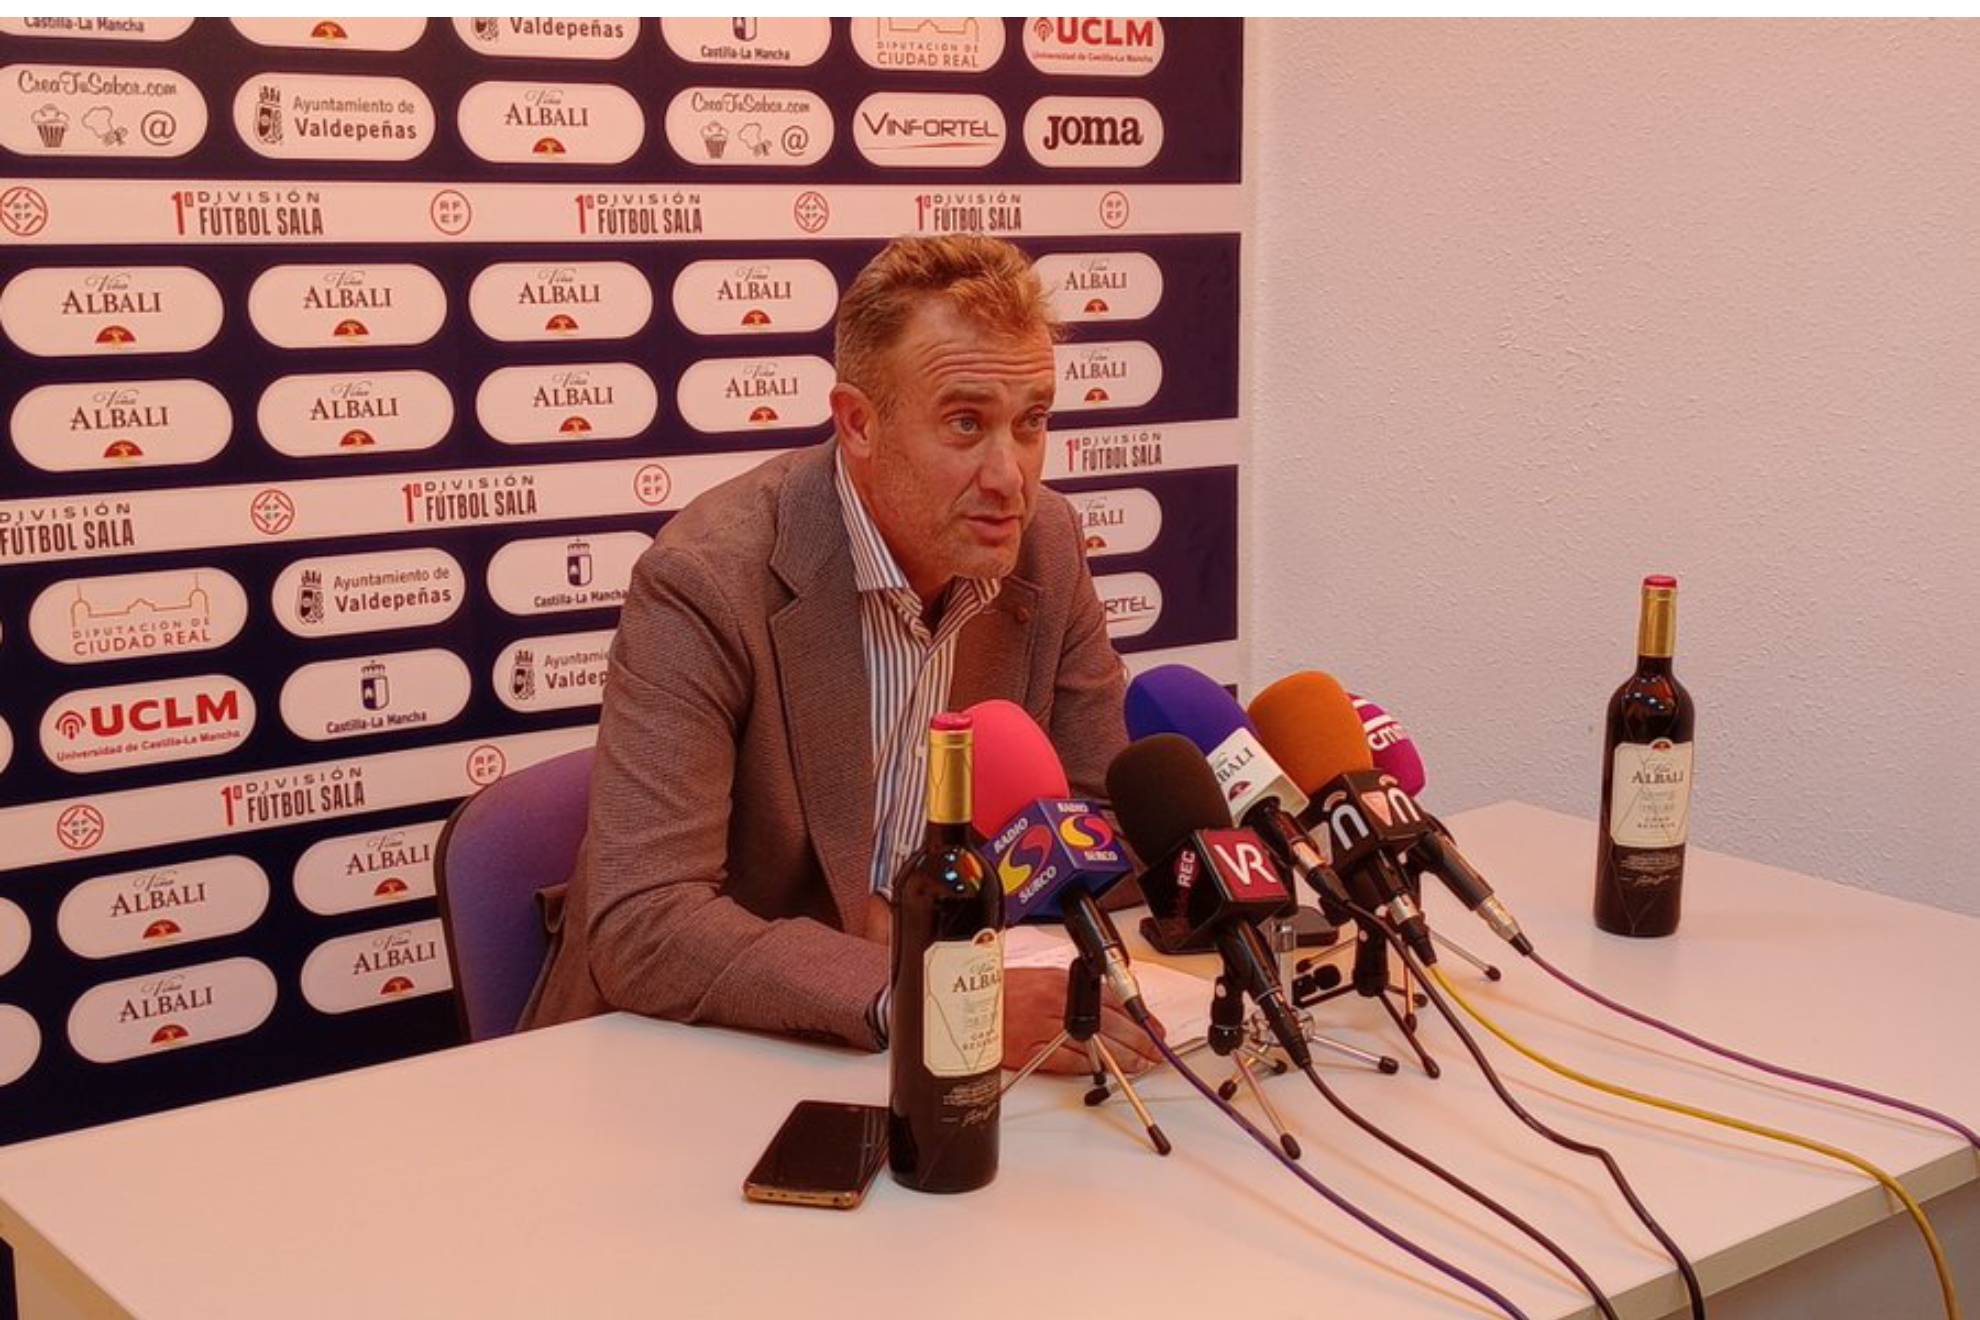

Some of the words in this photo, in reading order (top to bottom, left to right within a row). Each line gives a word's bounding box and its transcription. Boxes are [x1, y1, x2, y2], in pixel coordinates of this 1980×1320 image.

[510, 17, 624, 40] Valdepeñas
[1057, 17, 1153, 47] UCLM
[877, 51, 938, 66] CIUDAD
[943, 54, 980, 68] REAL
[293, 96, 398, 115] Ayuntamiento
[402, 101, 415, 114] de
[505, 104, 589, 127] ALBALI
[294, 118, 417, 141] Valdepeñas
[862, 111, 999, 138] VINFORTEL
[277, 206, 324, 236] SALA
[664, 207, 702, 234] SALA
[988, 206, 1022, 231] SALA
[519, 282, 600, 304] ALBALI
[717, 280, 791, 300] ALBALI
[1064, 271, 1127, 290] ALBALI
[62, 290, 161, 314] ALBALI
[303, 286, 391, 308] ALBALI
[1064, 361, 1127, 380] ALBALI
[533, 386, 614, 407] ALBALI
[725, 377, 798, 398] ALBALI
[71, 406, 169, 431] ALBALI
[310, 397, 399, 421] ALBALI
[1132, 444, 1162, 467] SALA
[494, 489, 537, 516] SALA
[83, 519, 135, 550] SALA
[334, 568, 430, 590] Ayuntamiento
[434, 565, 450, 581] de
[335, 587, 452, 613] Valdepeñas
[74, 635, 156, 656] CIUDAD
[163, 630, 211, 647] REAL
[545, 668, 608, 690] Valdep
[90, 690, 238, 737] UCLM
[125, 743, 138, 754] de
[321, 781, 365, 812] SALA
[345, 844, 431, 875] ALBALI
[1214, 843, 1277, 885] VR
[111, 882, 206, 917] ALBALI
[352, 942, 437, 975] ALBALI
[118, 987, 213, 1022] ALBALI
